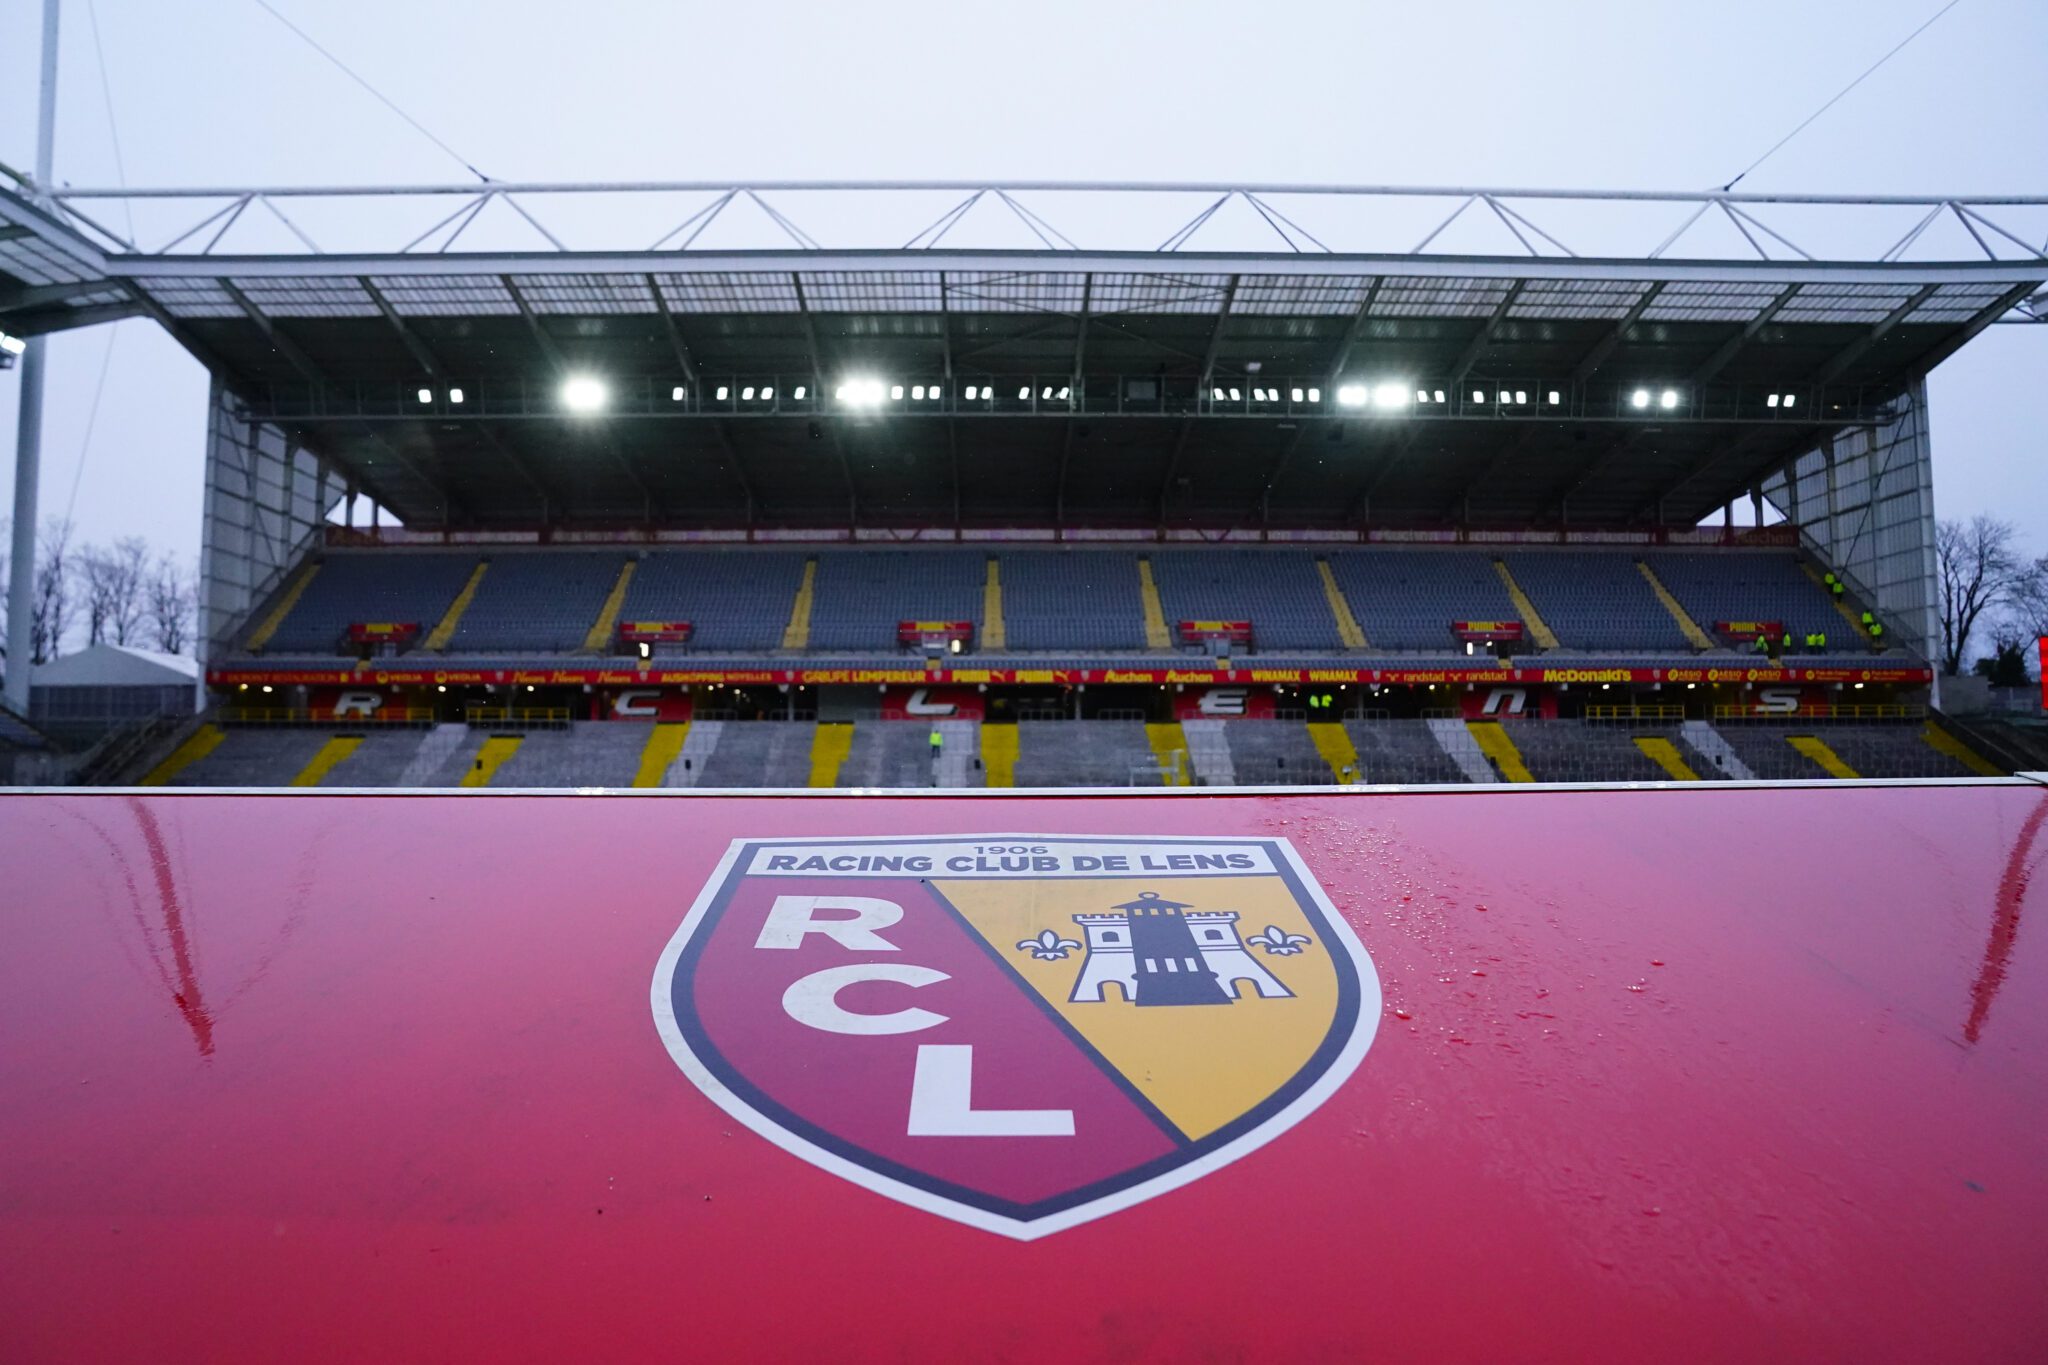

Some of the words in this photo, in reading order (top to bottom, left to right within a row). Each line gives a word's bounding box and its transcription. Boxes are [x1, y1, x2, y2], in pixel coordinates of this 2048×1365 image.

[802, 671, 849, 683] GROUPE
[852, 671, 926, 683] LEMPEREUR
[1104, 669, 1153, 683] Auchan
[1165, 669, 1214, 683] Auchan
[1251, 670, 1301, 682] WINAMAX
[1308, 670, 1358, 682] WINAMAX
[1403, 671, 1445, 682] randstad
[1466, 670, 1507, 681] randstad
[1543, 669, 1632, 683] McDonald's
[973, 846, 1049, 855] 1906
[766, 855, 933, 872] RACING
[945, 855, 1061, 872] CLUB
[1072, 855, 1130, 872] DE
[1140, 853, 1256, 870] LENS
[754, 895, 904, 951] R
[781, 963, 953, 1036] C
[907, 1044, 1076, 1137] L
